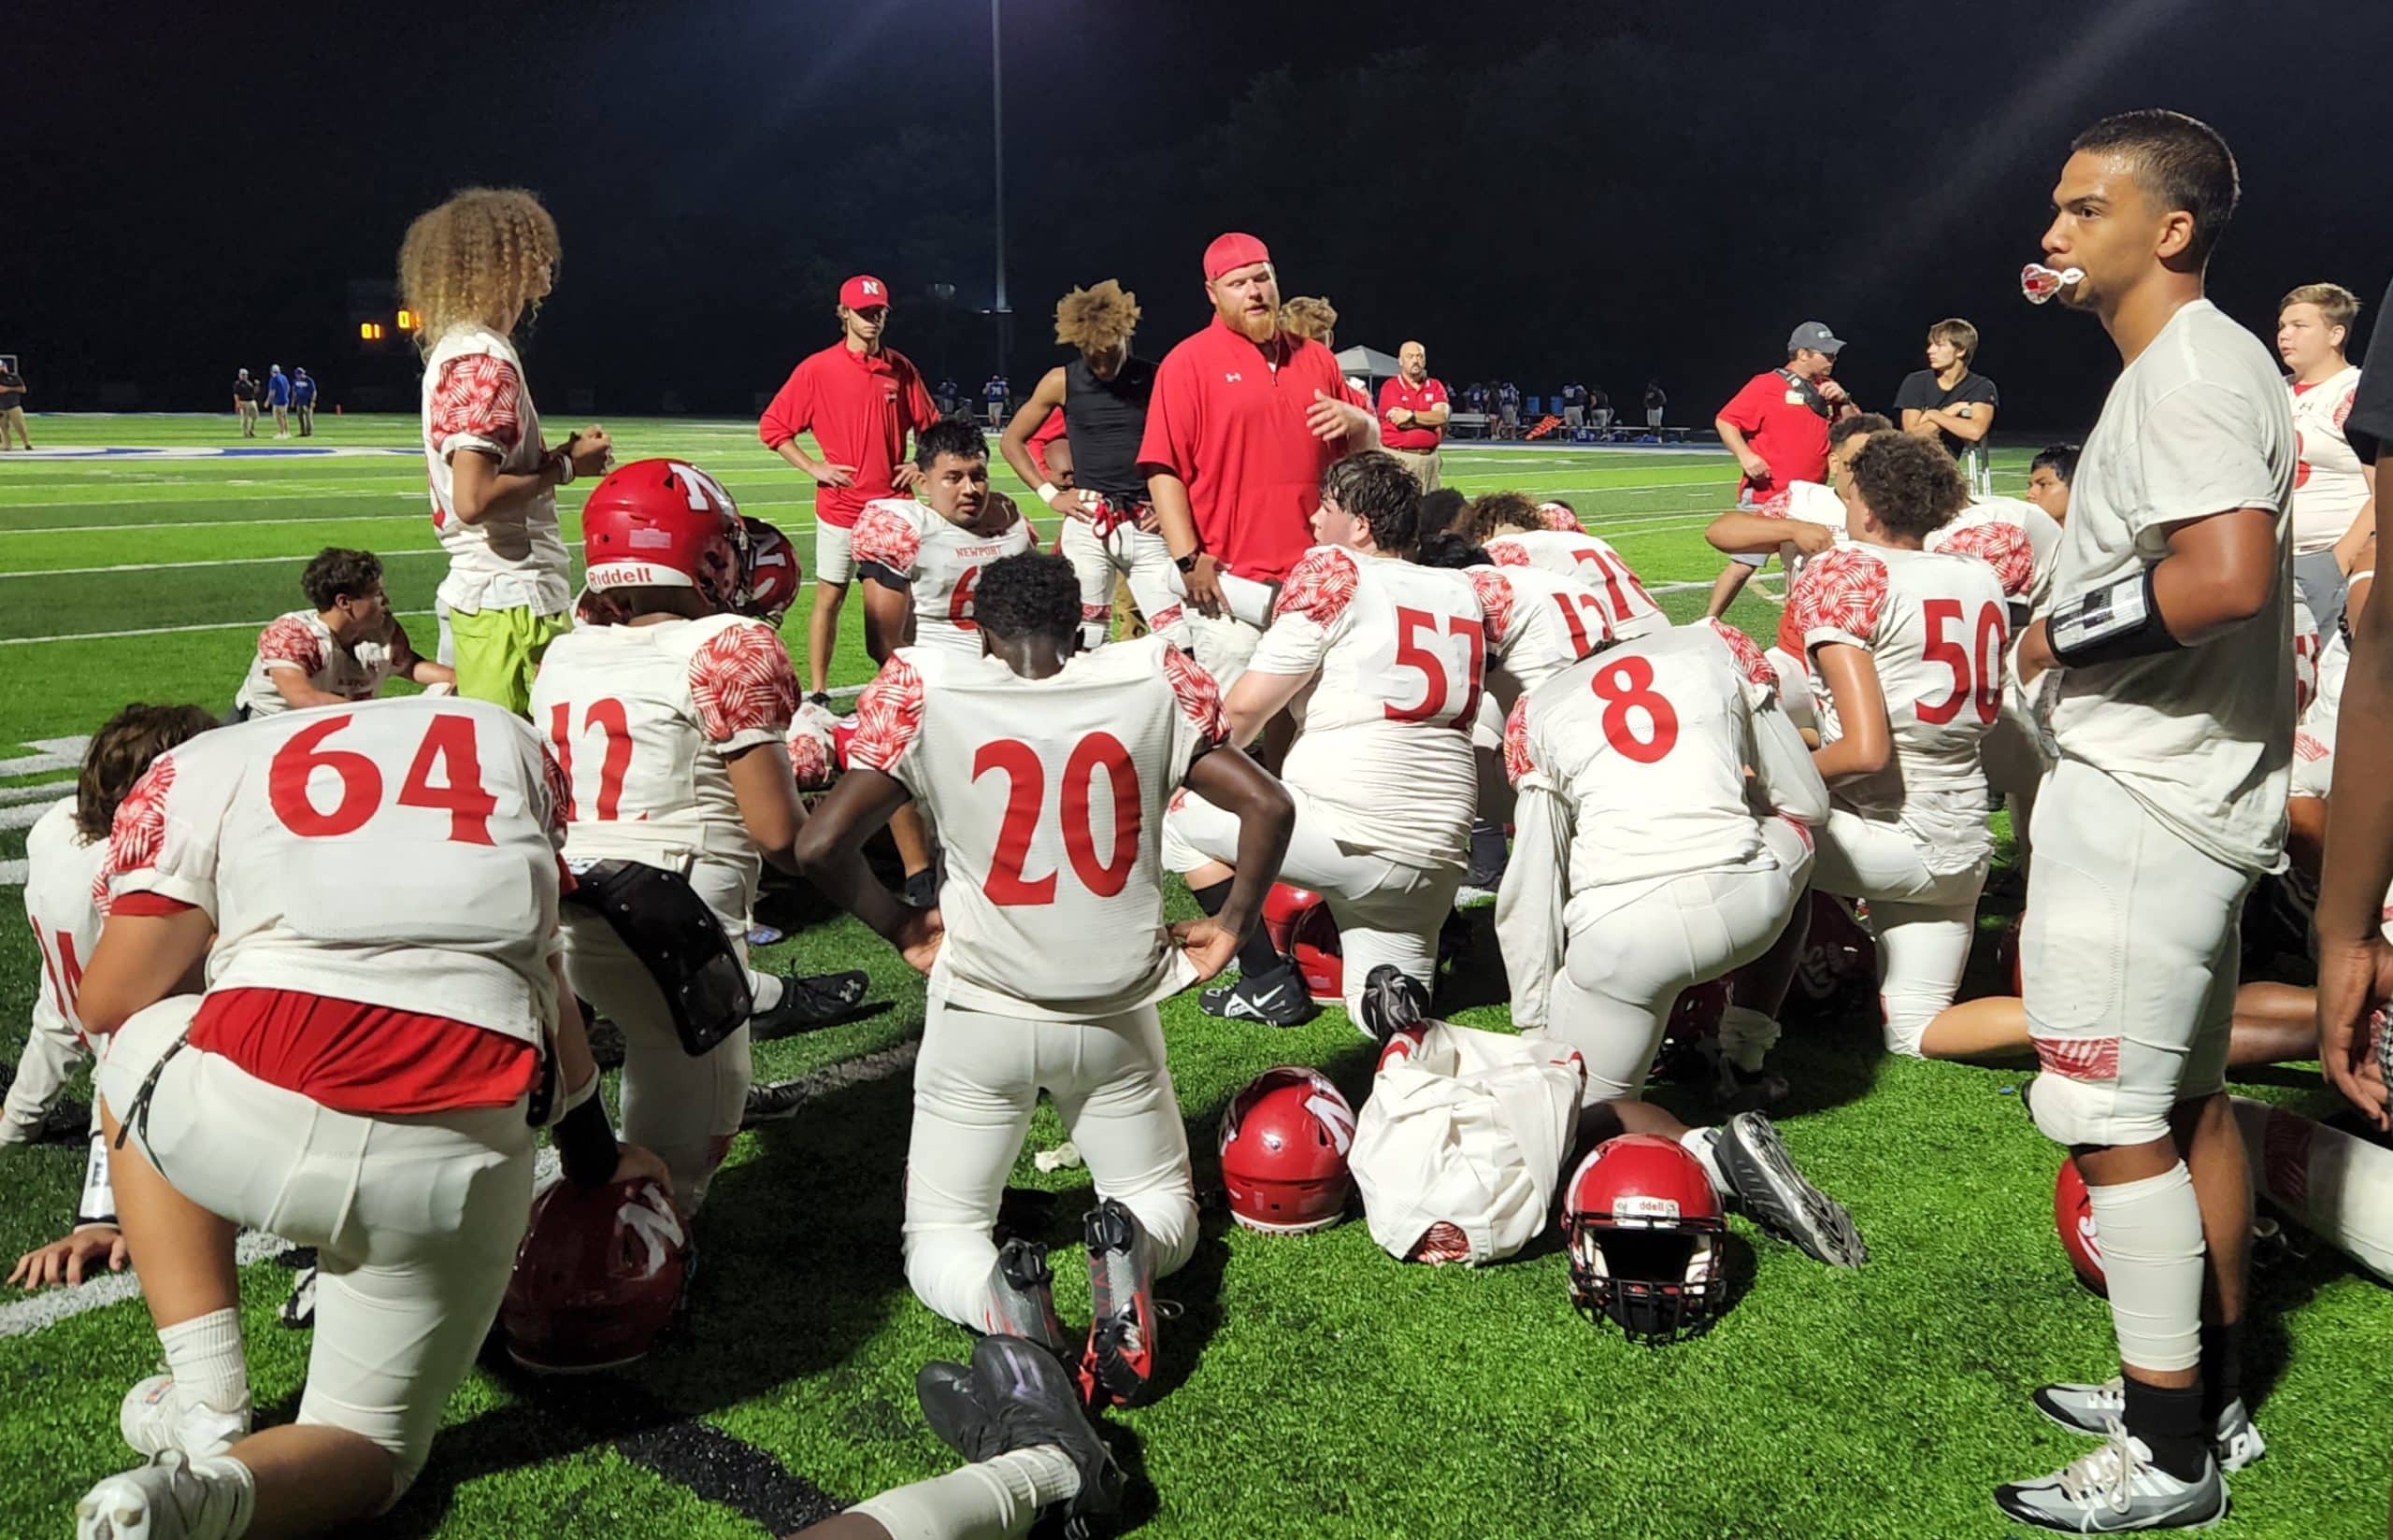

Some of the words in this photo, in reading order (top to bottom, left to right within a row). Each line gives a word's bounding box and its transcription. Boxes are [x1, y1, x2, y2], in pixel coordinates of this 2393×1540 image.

[862, 280, 879, 295] N
[588, 567, 652, 586] Riddell
[954, 545, 1003, 558] NEWPORT
[1383, 606, 1483, 725] 57
[1591, 655, 1679, 763] 8
[1914, 599, 2008, 725] 50
[269, 713, 499, 846] 64
[971, 731, 1141, 905] 20
